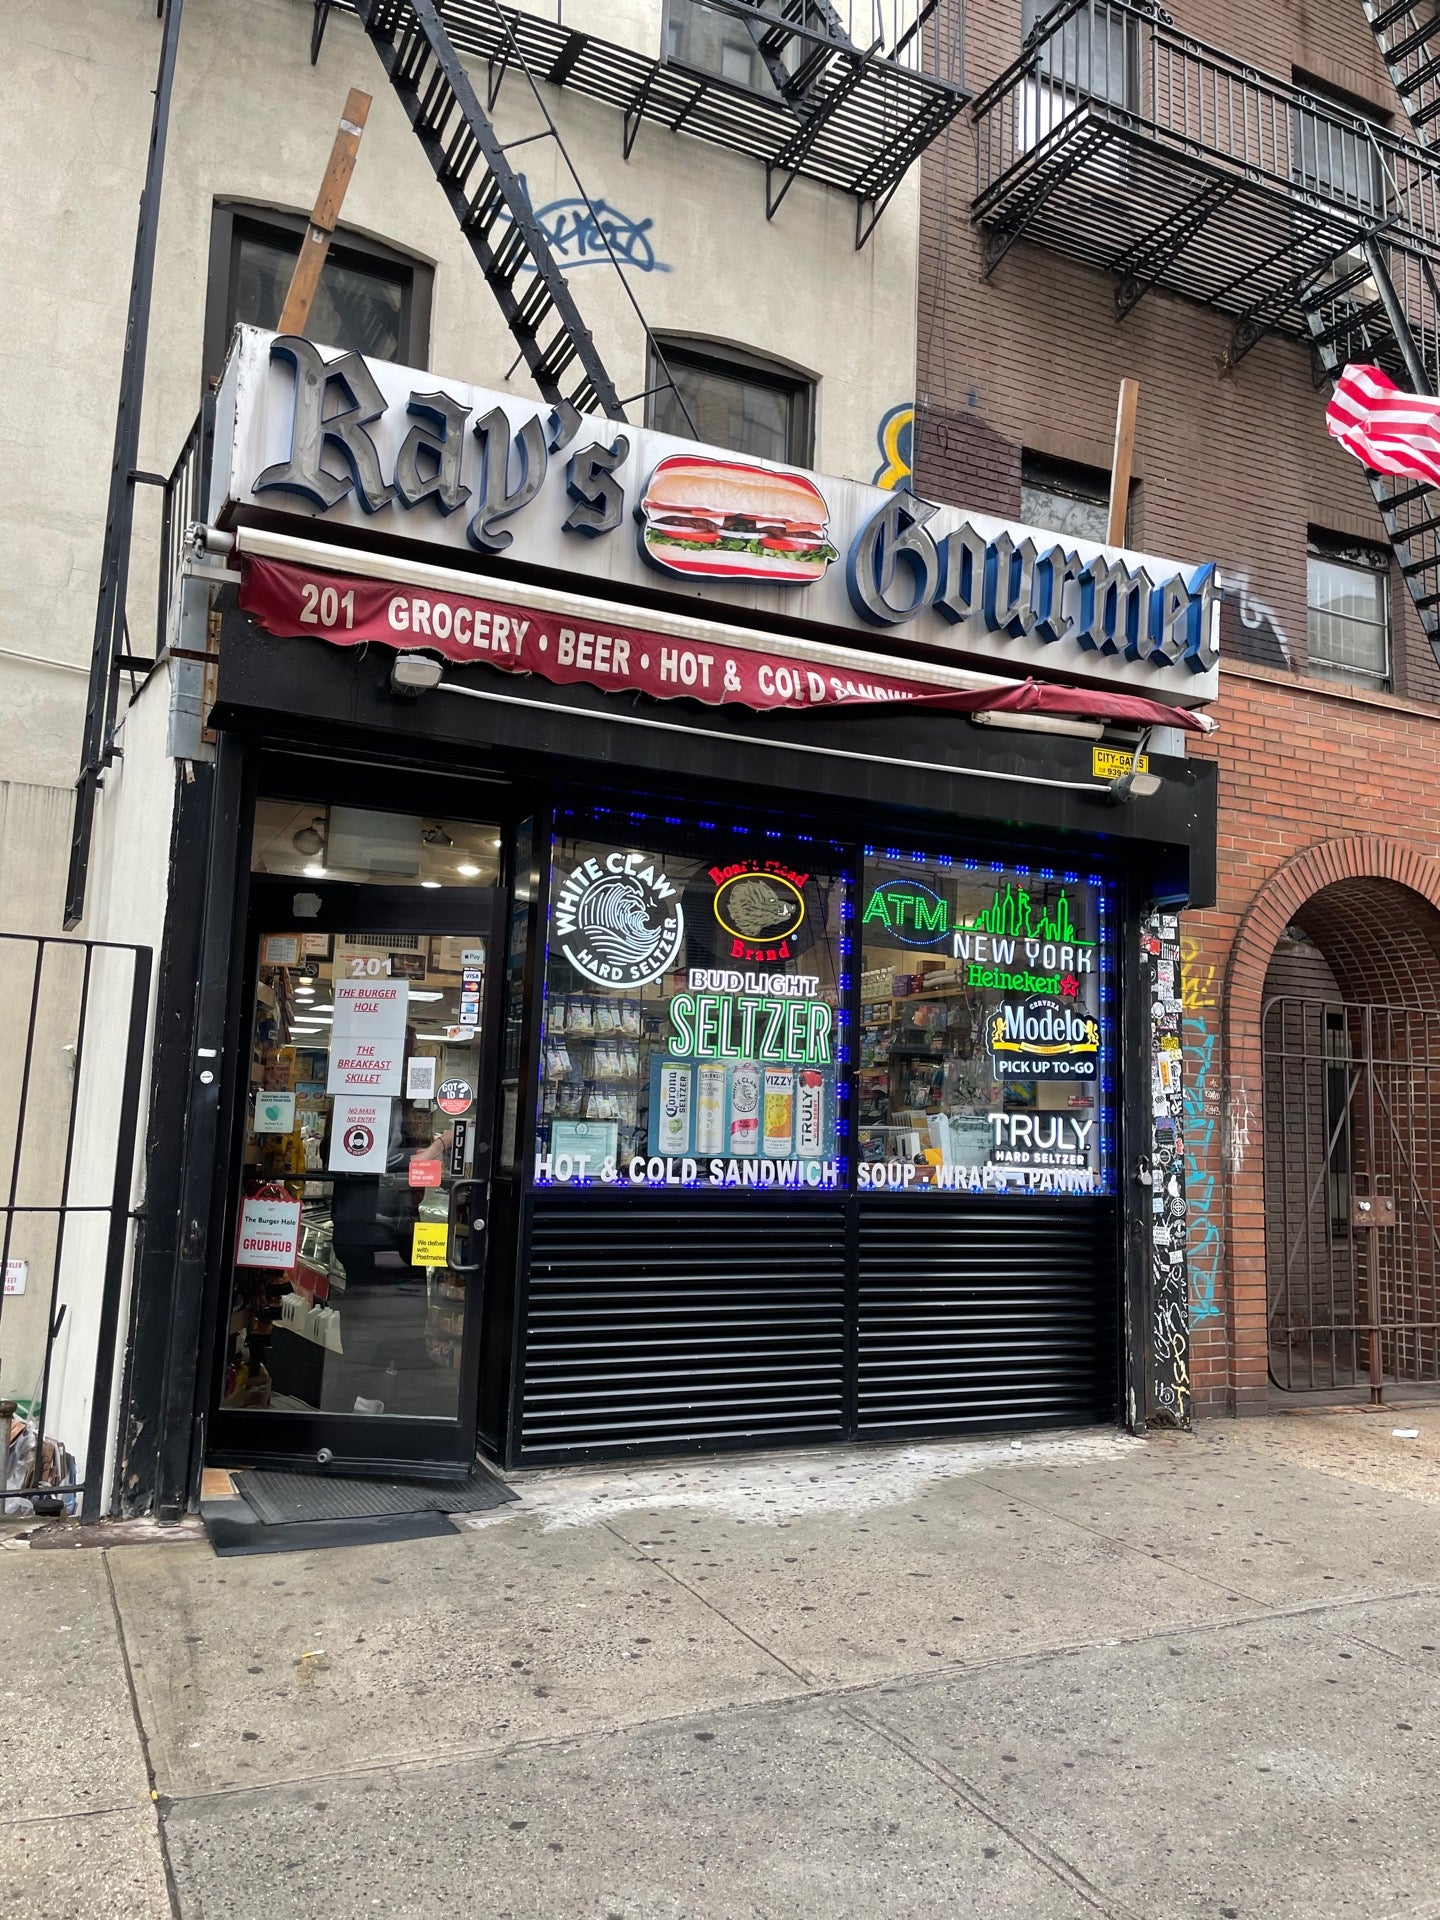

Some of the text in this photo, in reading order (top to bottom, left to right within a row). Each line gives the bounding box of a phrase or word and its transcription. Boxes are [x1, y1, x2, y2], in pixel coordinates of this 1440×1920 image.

[252, 334, 1224, 674] Ray's Gourmet
[300, 583, 355, 629] 201
[388, 596, 530, 656] GROCERY
[557, 629, 630, 675] BEER
[660, 647, 714, 688] HOT
[723, 659, 741, 692] &
[758, 664, 826, 702] COLD
[1097, 751, 1145, 769] CITY-GATS
[555, 852, 676, 936] WHITE CLAW
[862, 891, 948, 932] ATM
[576, 917, 677, 981] HARD SELTZER
[730, 939, 790, 961] Brand
[953, 933, 1092, 974] NEW YORK
[351, 958, 392, 977] 201
[967, 964, 1060, 995] Heineken
[338, 989, 397, 999] THE BURGER
[689, 968, 819, 997] BUD LIGHT
[354, 1002, 379, 1012] HOLE
[1029, 1000, 1060, 1011] CERVEZA
[669, 993, 832, 1064] SELTZER
[1004, 1005, 1085, 1042] Modelo
[356, 1046, 375, 1056] THE
[337, 1059, 391, 1070] BREAKFAST
[1000, 1061, 1094, 1074] PICK UP TO-GO
[345, 1073, 381, 1084] SKILLET
[442, 1083, 458, 1092] GOT
[766, 1075, 792, 1086] VIZZY
[447, 1091, 456, 1099] ID
[665, 1072, 678, 1118] Corona
[679, 1076, 687, 1114] SELTZER
[802, 1091, 813, 1146] TRULY
[453, 1125, 465, 1171] PULL
[995, 1150, 1085, 1166] HARD SELTZER
[535, 1153, 837, 1187] HOT & COLD SANDWICH
[857, 1162, 1094, 1192] SOUP WRAPS PANINI
[258, 1217, 279, 1226] Burger
[281, 1218, 296, 1226] Hole
[243, 1238, 292, 1253] GRUBHUB
